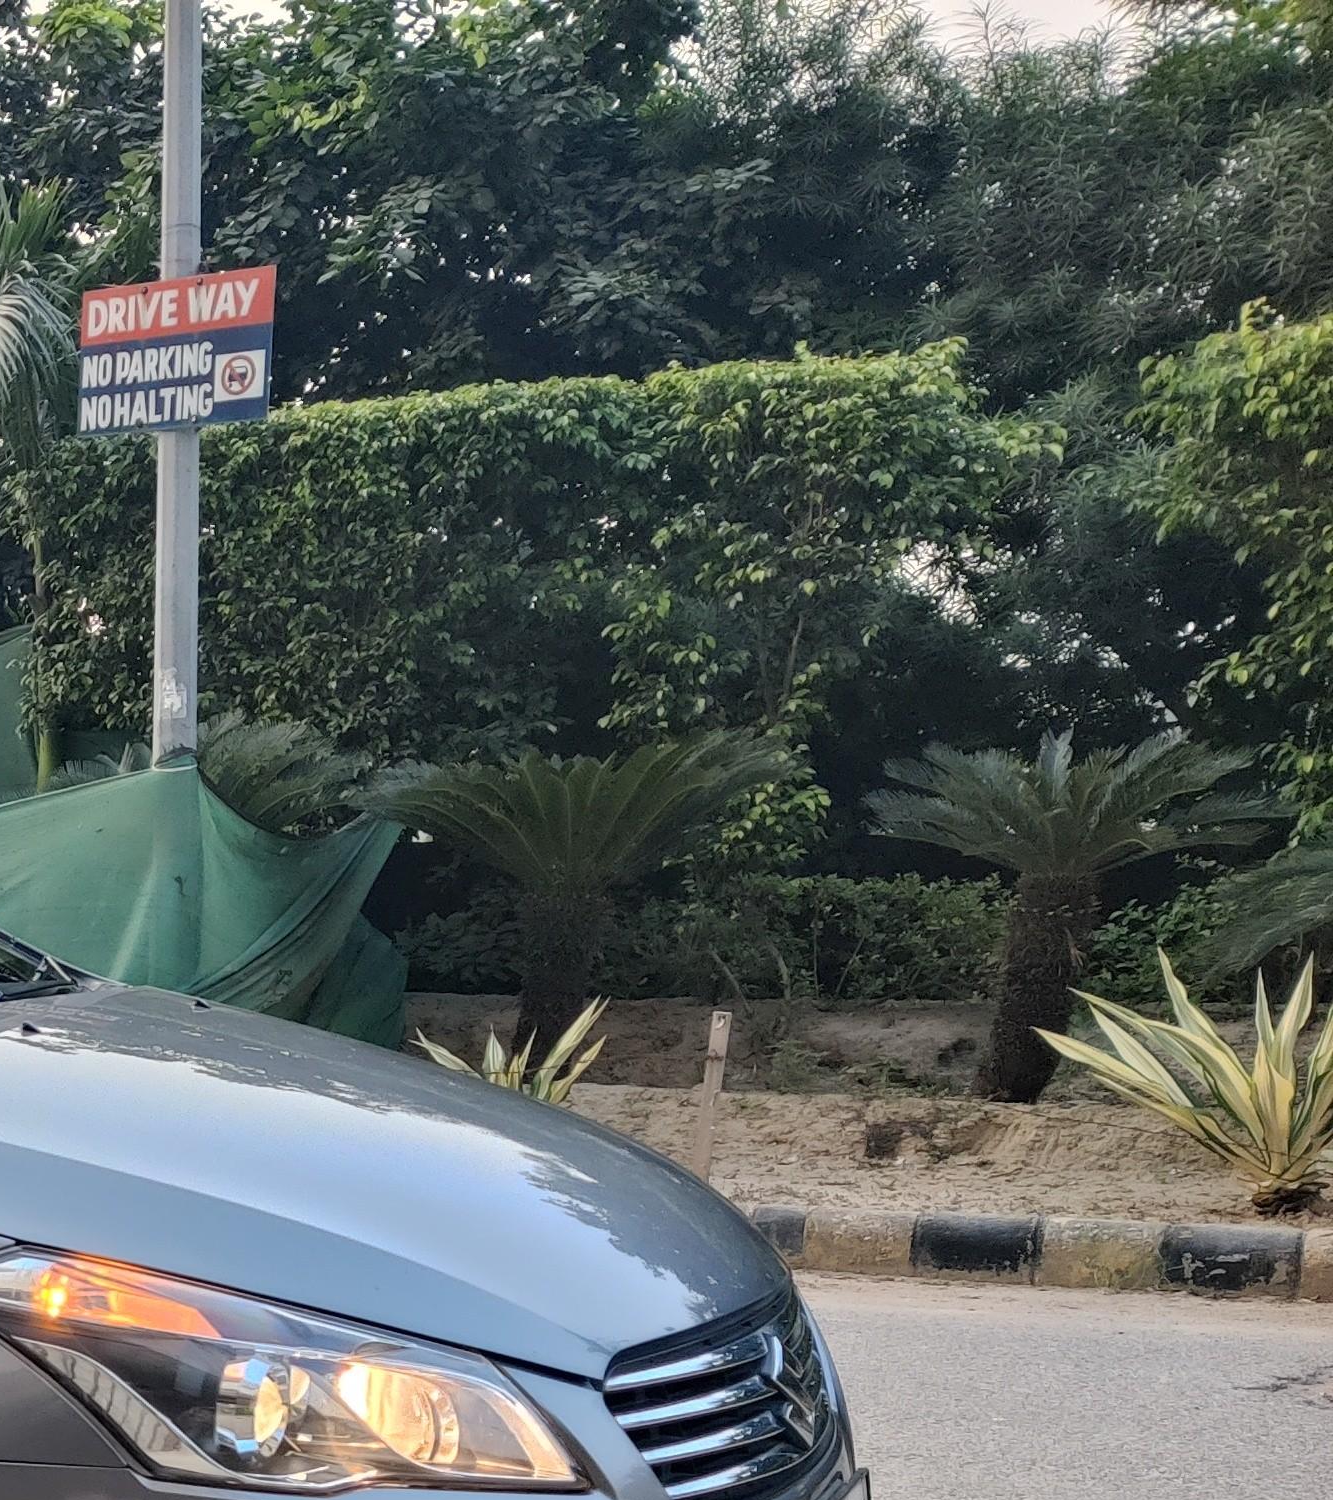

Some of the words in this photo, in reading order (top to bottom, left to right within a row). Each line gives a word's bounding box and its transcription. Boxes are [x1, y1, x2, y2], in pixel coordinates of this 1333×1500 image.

[87, 288, 179, 338] DRIVE
[188, 278, 259, 323] WAY
[82, 353, 112, 388] NO
[115, 341, 213, 385] PARKING
[80, 394, 113, 432] NO
[113, 383, 213, 427] HALTING
